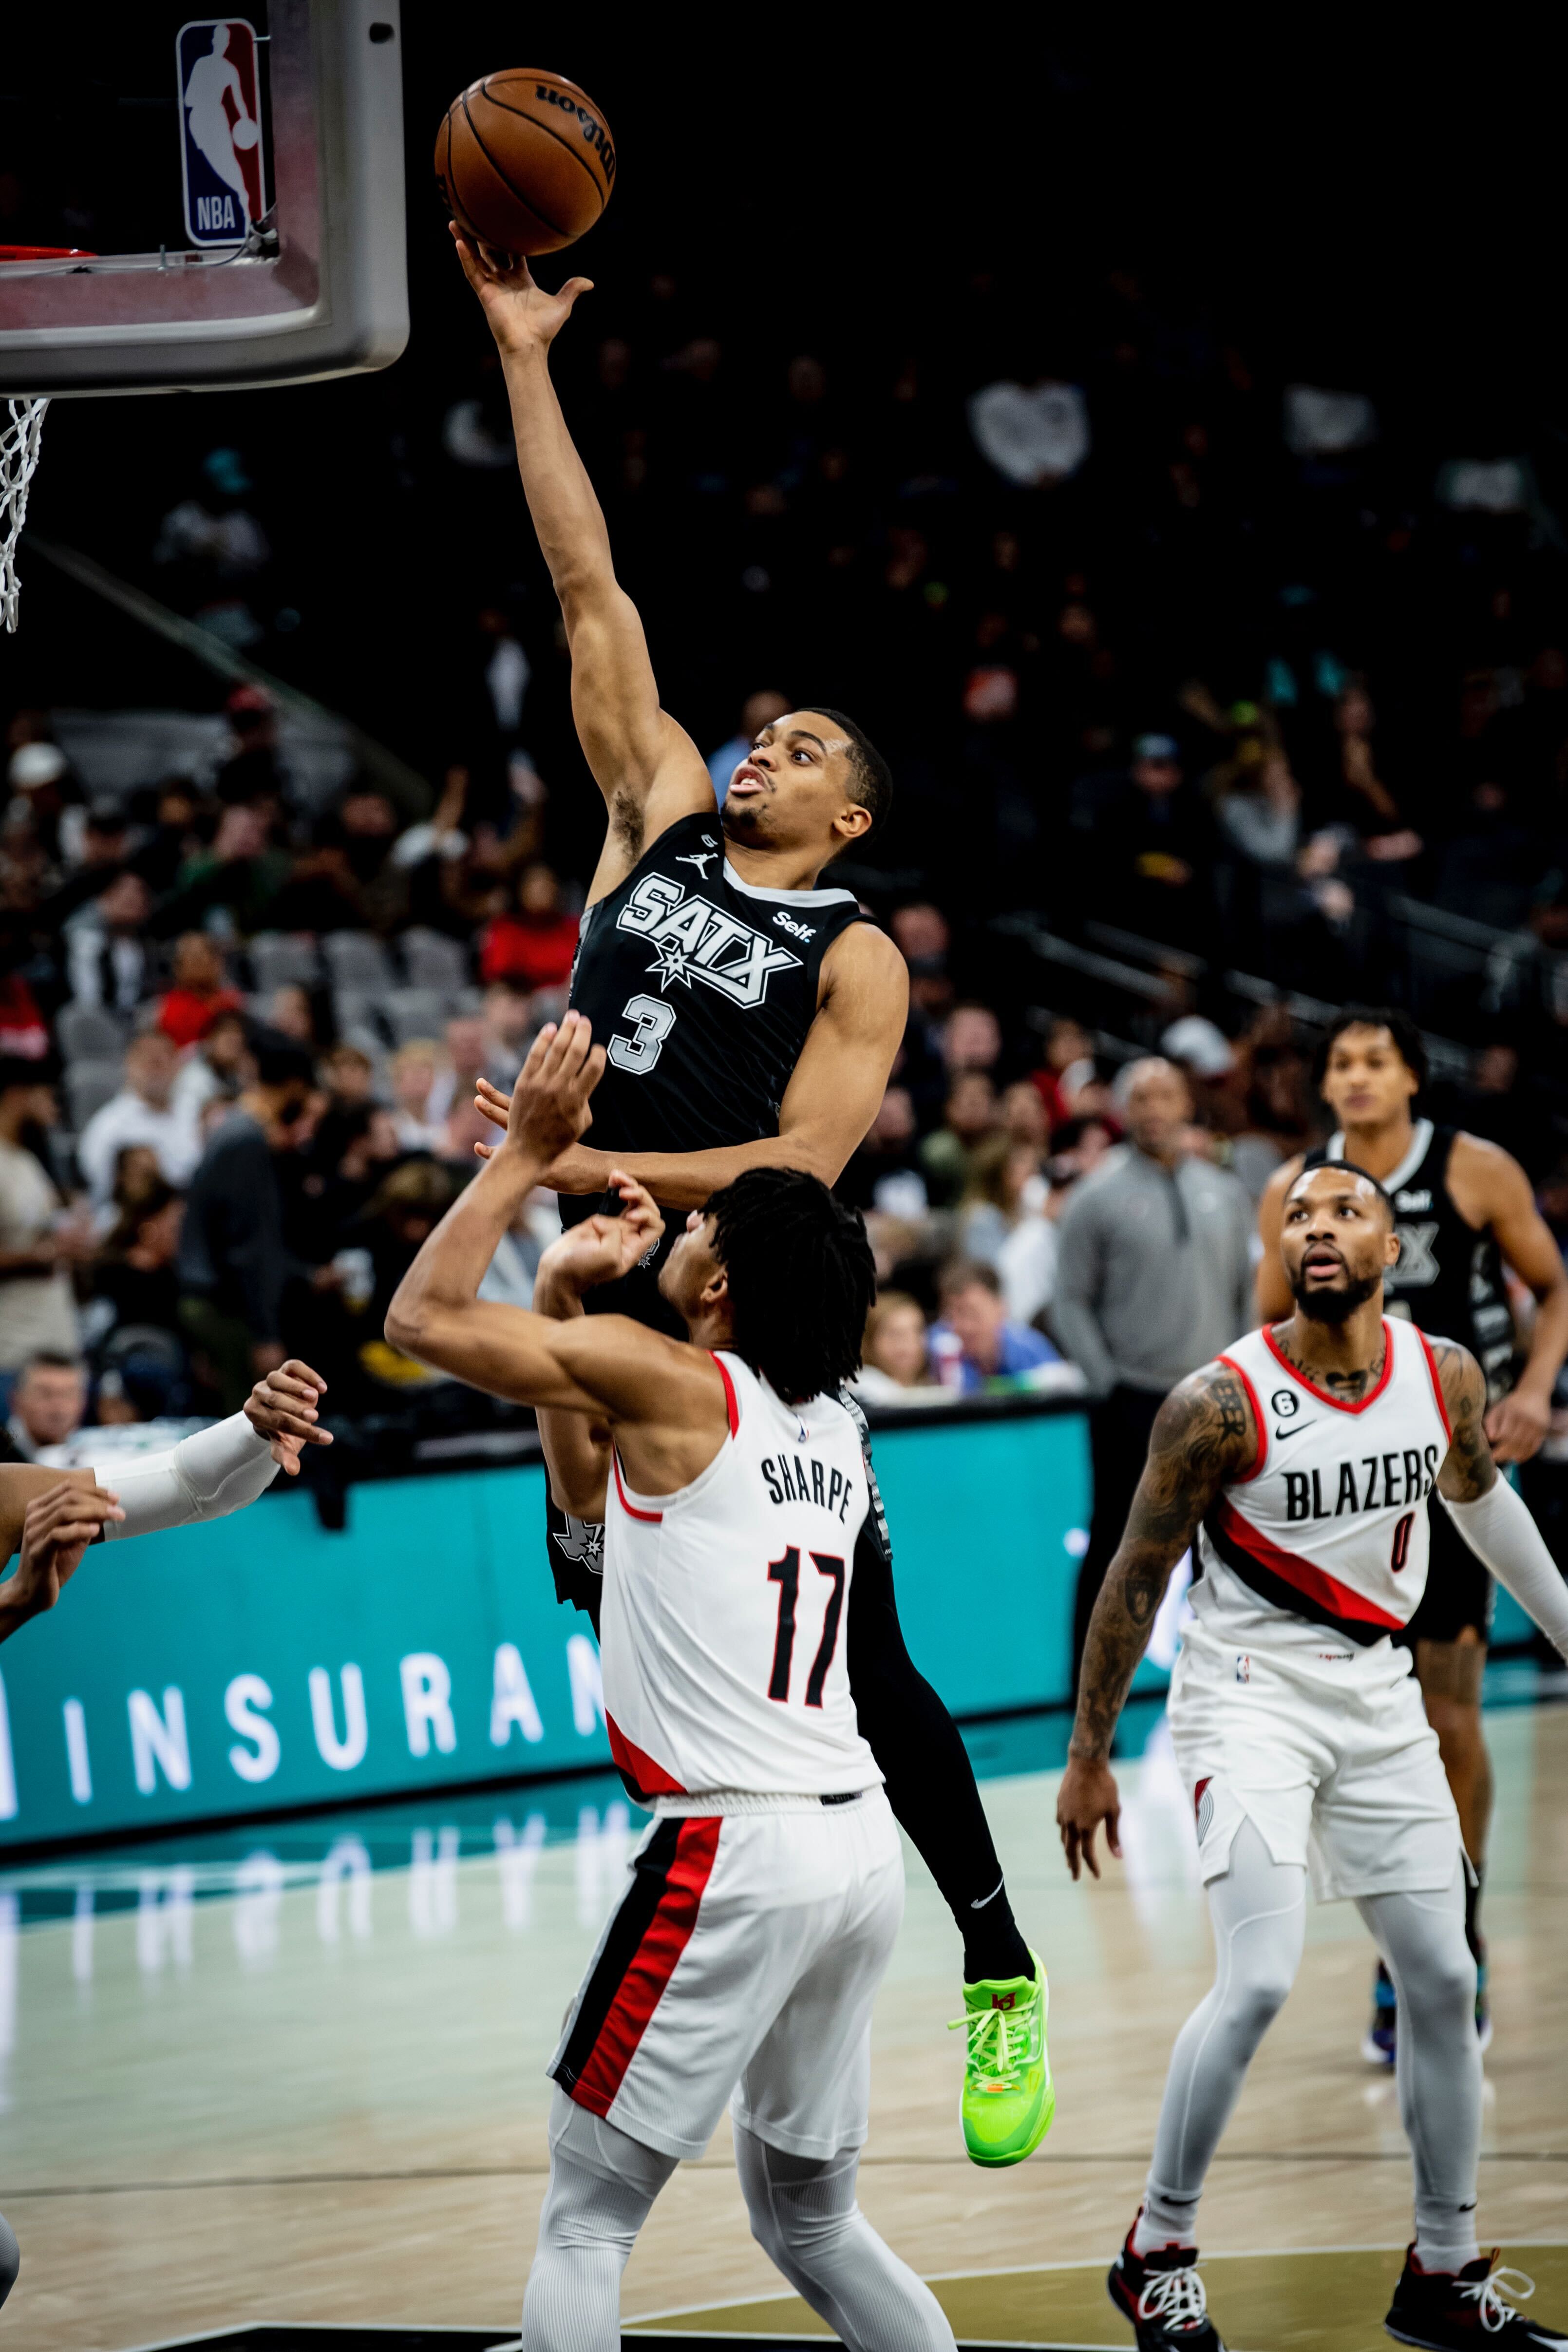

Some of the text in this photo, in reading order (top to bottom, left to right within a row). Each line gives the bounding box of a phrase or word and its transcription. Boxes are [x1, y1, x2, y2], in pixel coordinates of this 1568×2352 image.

[535, 85, 616, 184] Wilson
[197, 195, 236, 230] NBA
[616, 872, 804, 1009] SATX
[607, 993, 677, 1075] 3
[1274, 1392, 1296, 1416] 6
[761, 1454, 852, 1525] SHARPE
[1282, 1444, 1439, 1521] BLAZERS
[1391, 1511, 1416, 1573] 0
[767, 1544, 845, 1709] 17
